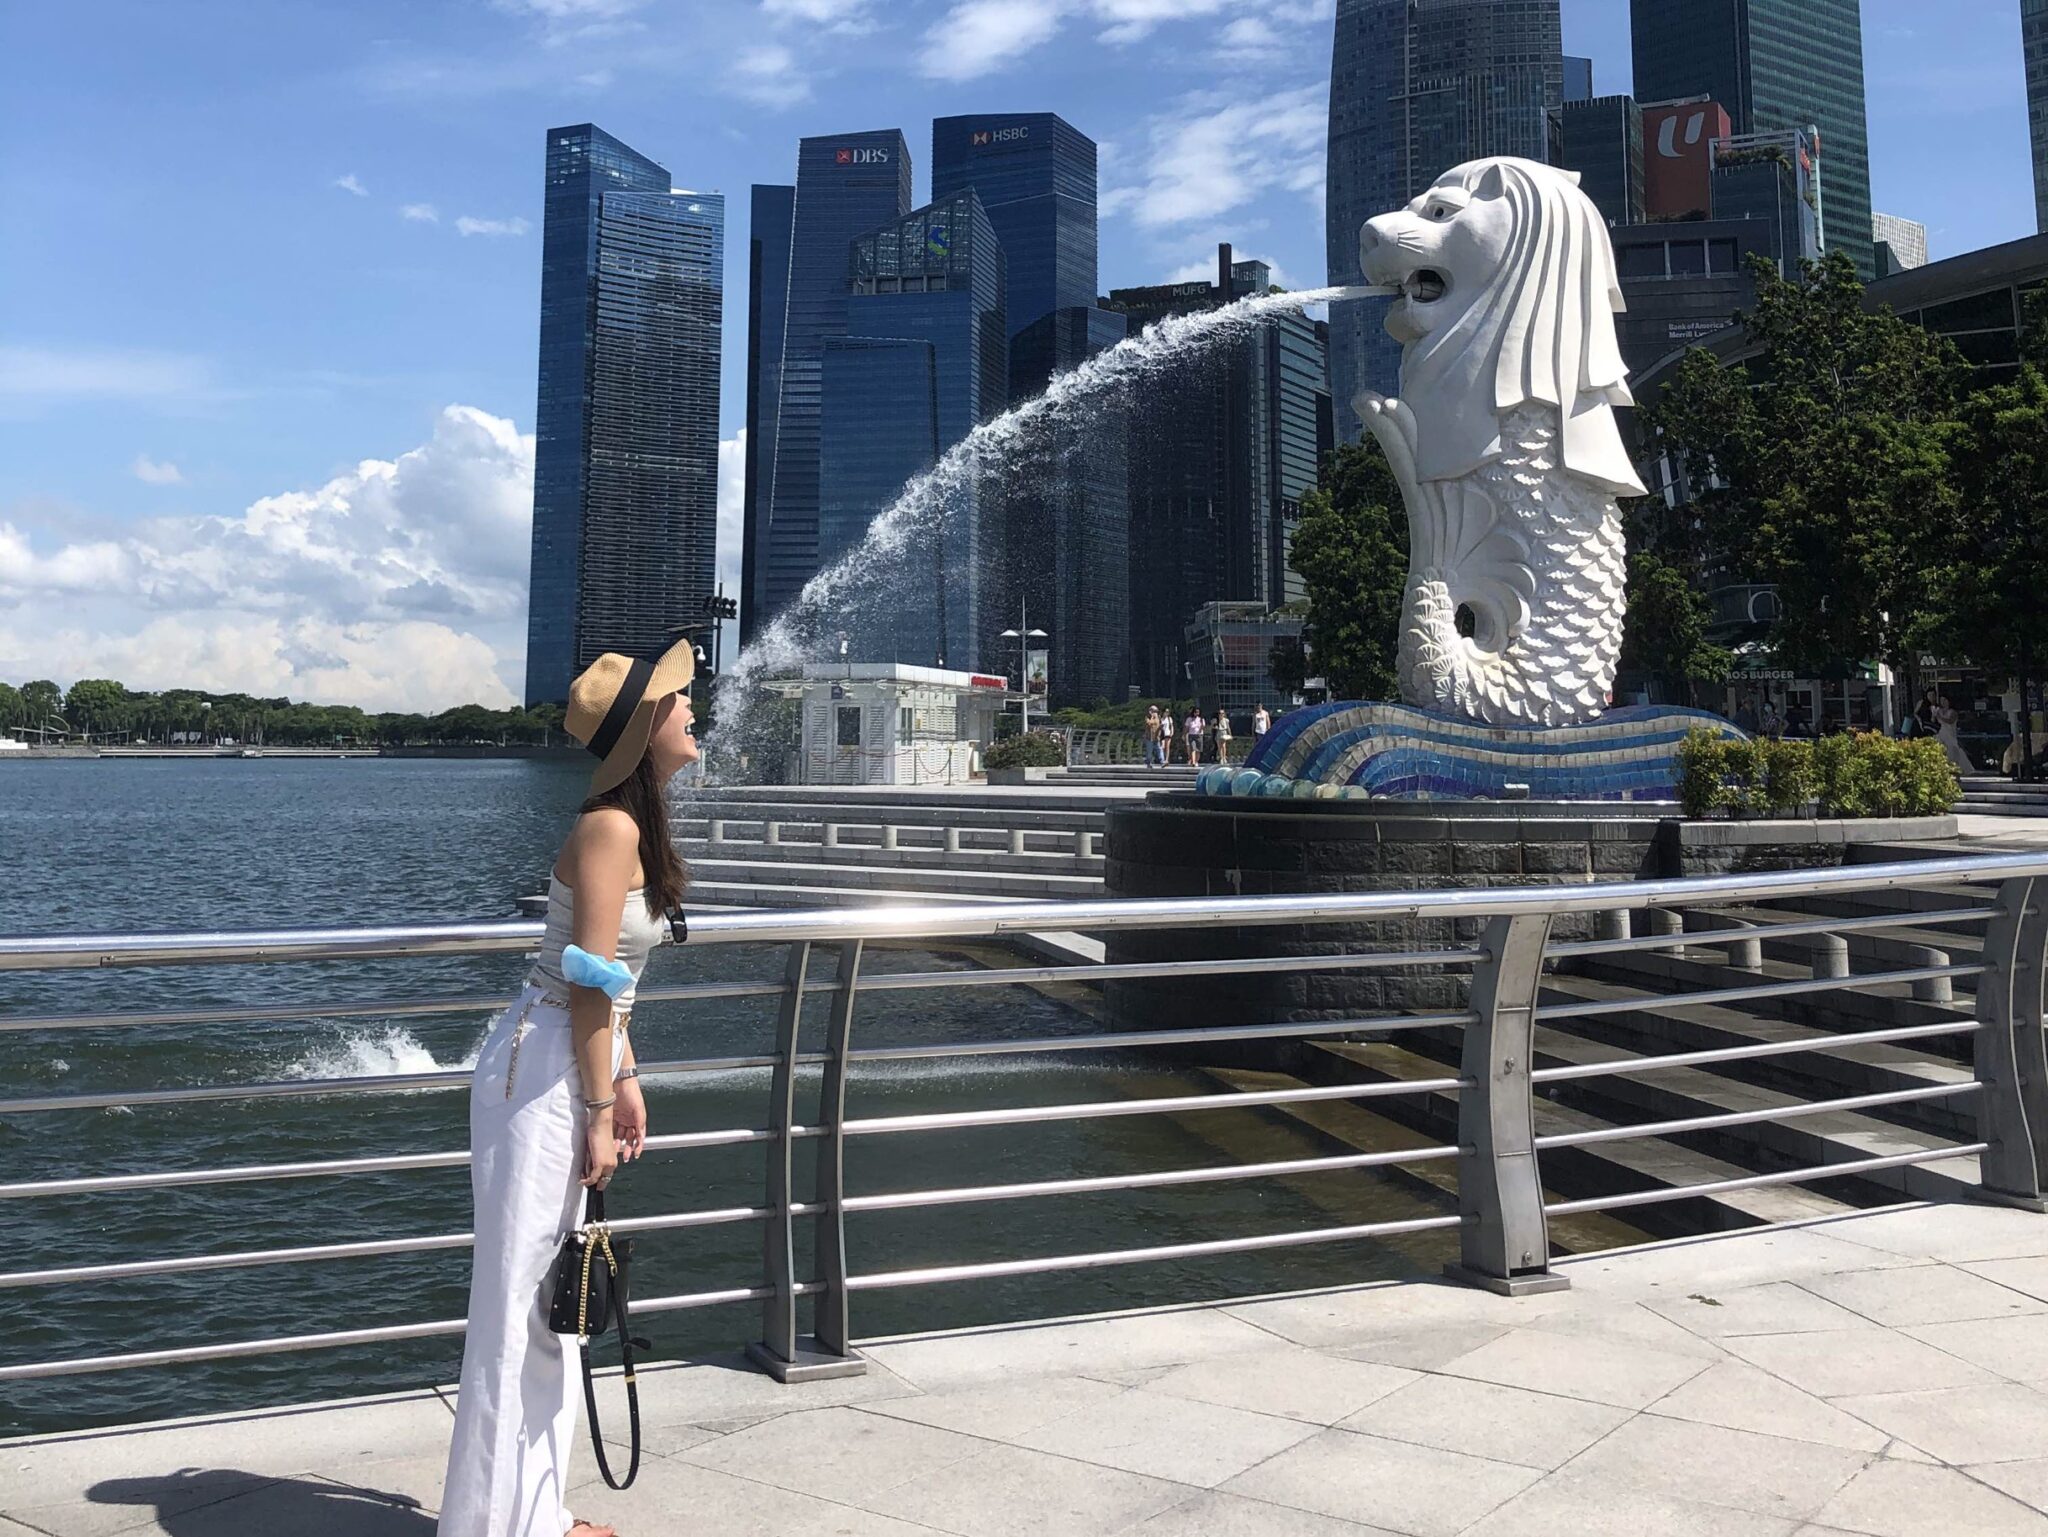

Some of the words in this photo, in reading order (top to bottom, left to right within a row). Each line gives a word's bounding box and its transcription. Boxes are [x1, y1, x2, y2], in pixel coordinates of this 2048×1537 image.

[992, 126, 1029, 142] HSBC
[853, 148, 889, 163] DBS
[1172, 284, 1206, 297] MUFG
[1668, 323, 1686, 331] Bank
[1695, 321, 1725, 329] America
[1668, 330, 1693, 338] Merrill
[1749, 670, 1795, 680] BURGER
